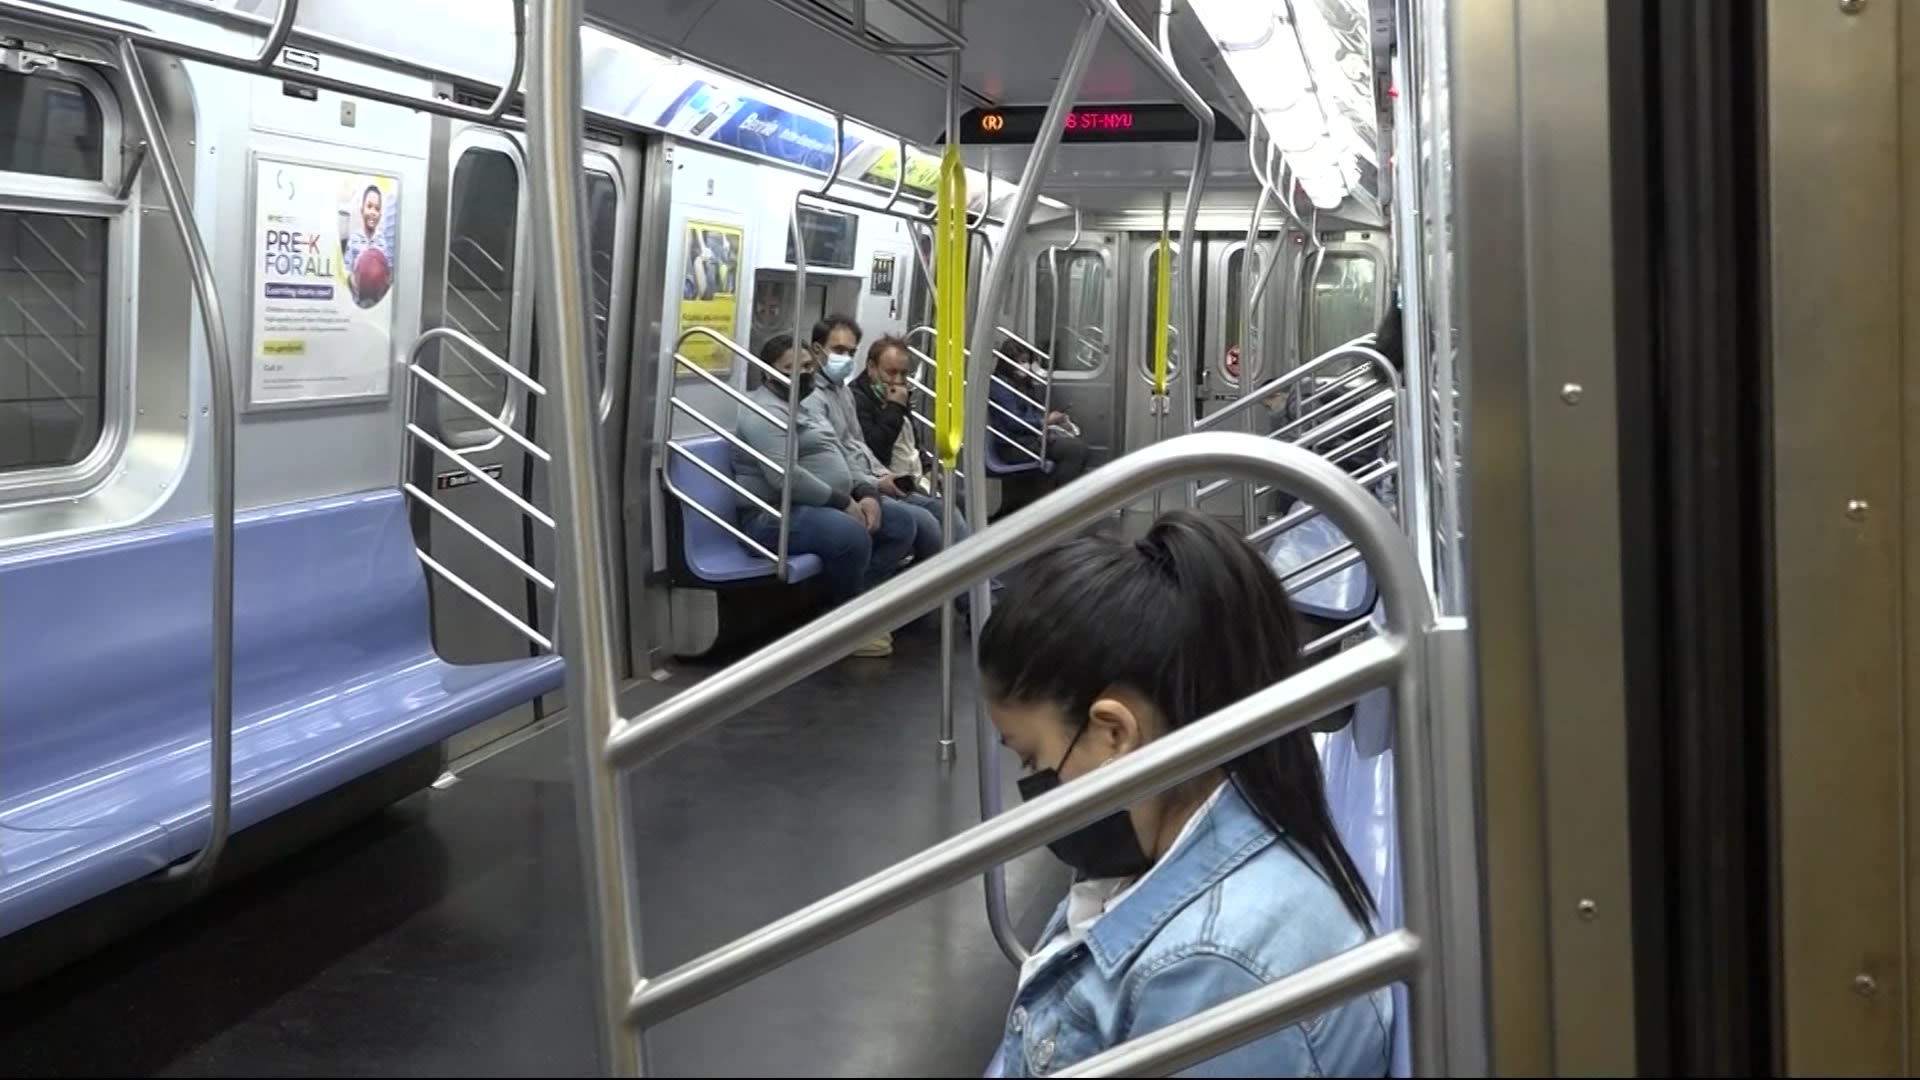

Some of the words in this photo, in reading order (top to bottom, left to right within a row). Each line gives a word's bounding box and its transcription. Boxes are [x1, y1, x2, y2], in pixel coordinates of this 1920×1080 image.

[981, 114, 1004, 130] (R)
[1080, 112, 1133, 129] ST-NYU
[265, 229, 321, 255] PRE-K
[264, 252, 303, 276] FOR
[304, 256, 335, 278] ALL
